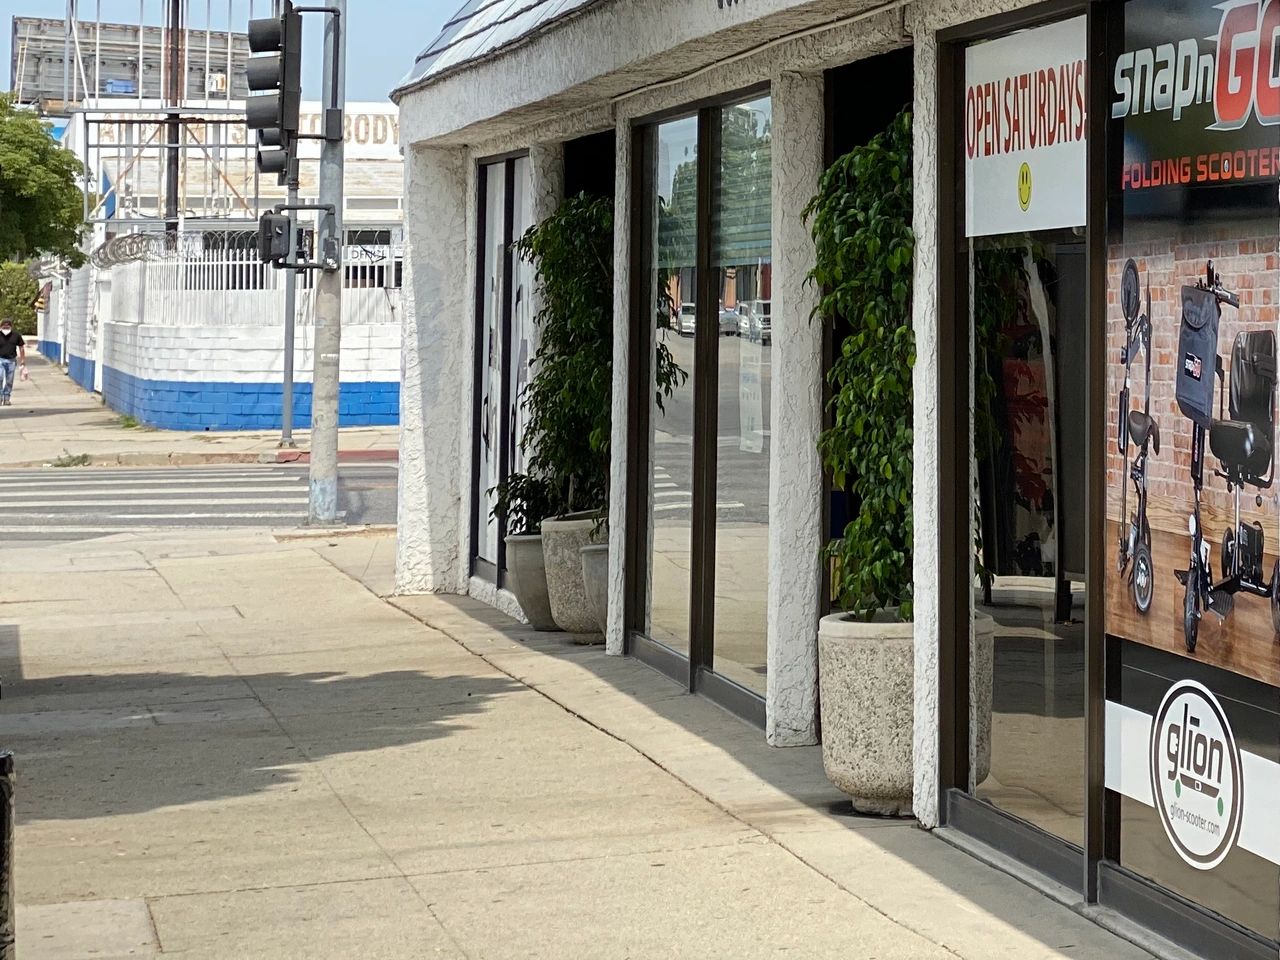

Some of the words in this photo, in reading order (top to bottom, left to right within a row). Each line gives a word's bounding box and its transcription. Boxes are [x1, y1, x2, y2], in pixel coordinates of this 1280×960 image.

[965, 81, 1001, 160] OPEN
[1122, 156, 1191, 190] FOLDING
[1166, 702, 1224, 784] glion
